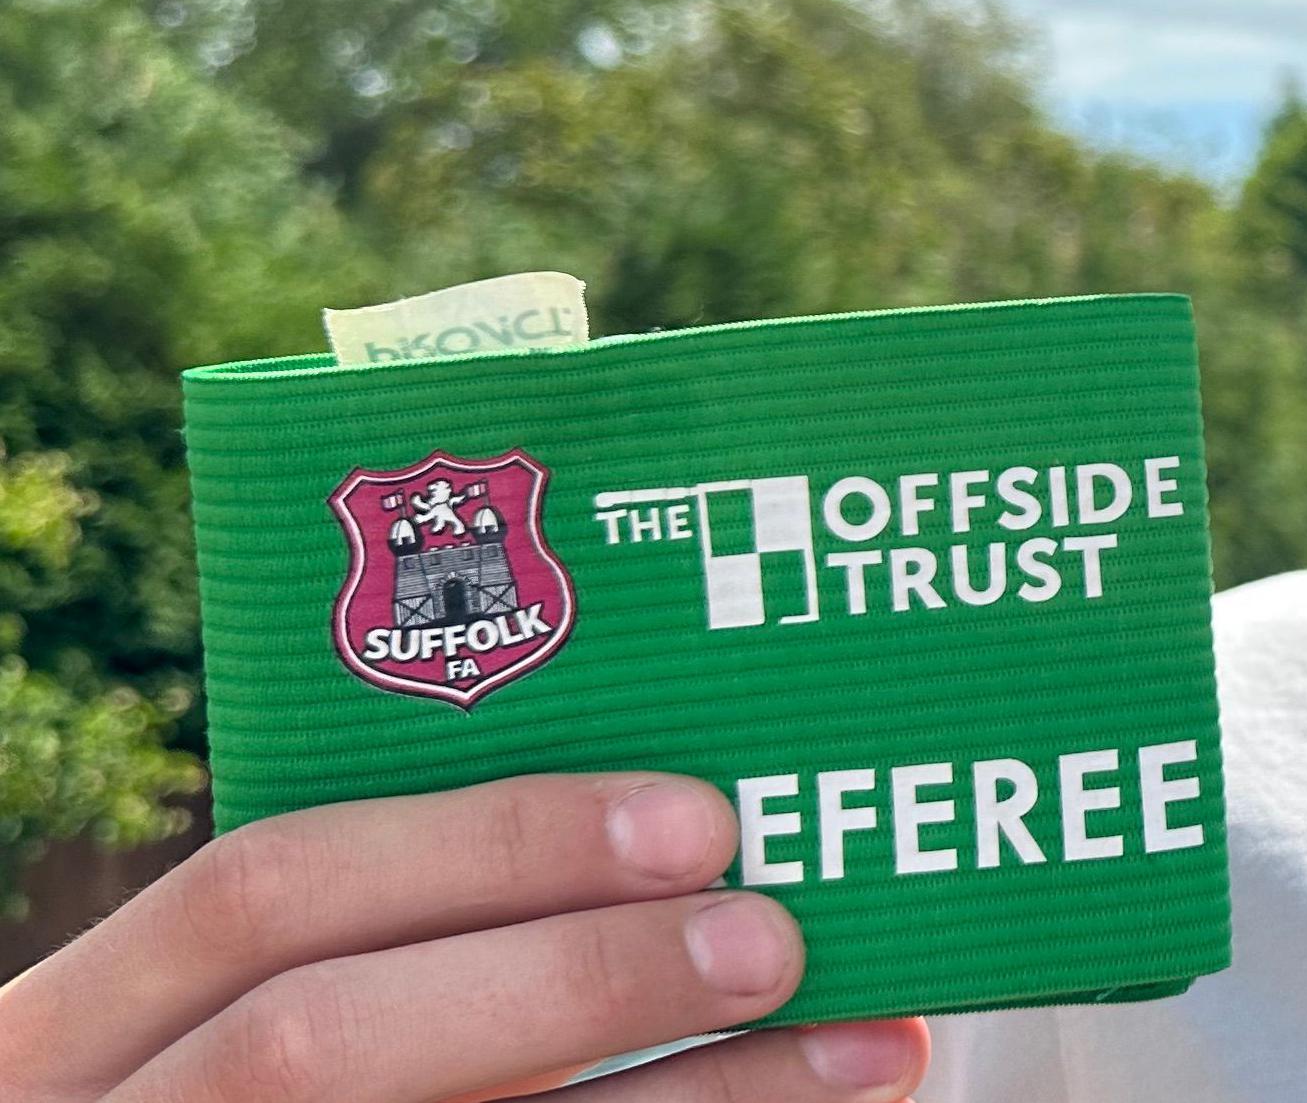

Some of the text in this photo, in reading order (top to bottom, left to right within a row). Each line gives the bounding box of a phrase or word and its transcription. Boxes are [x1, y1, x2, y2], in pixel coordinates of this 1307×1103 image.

[594, 455, 1184, 545] THE OFFSIDE
[826, 533, 1118, 616] TRUST
[362, 603, 552, 661] SUFFOLK
[446, 658, 480, 680] FA
[711, 739, 1204, 887] EFEREE
